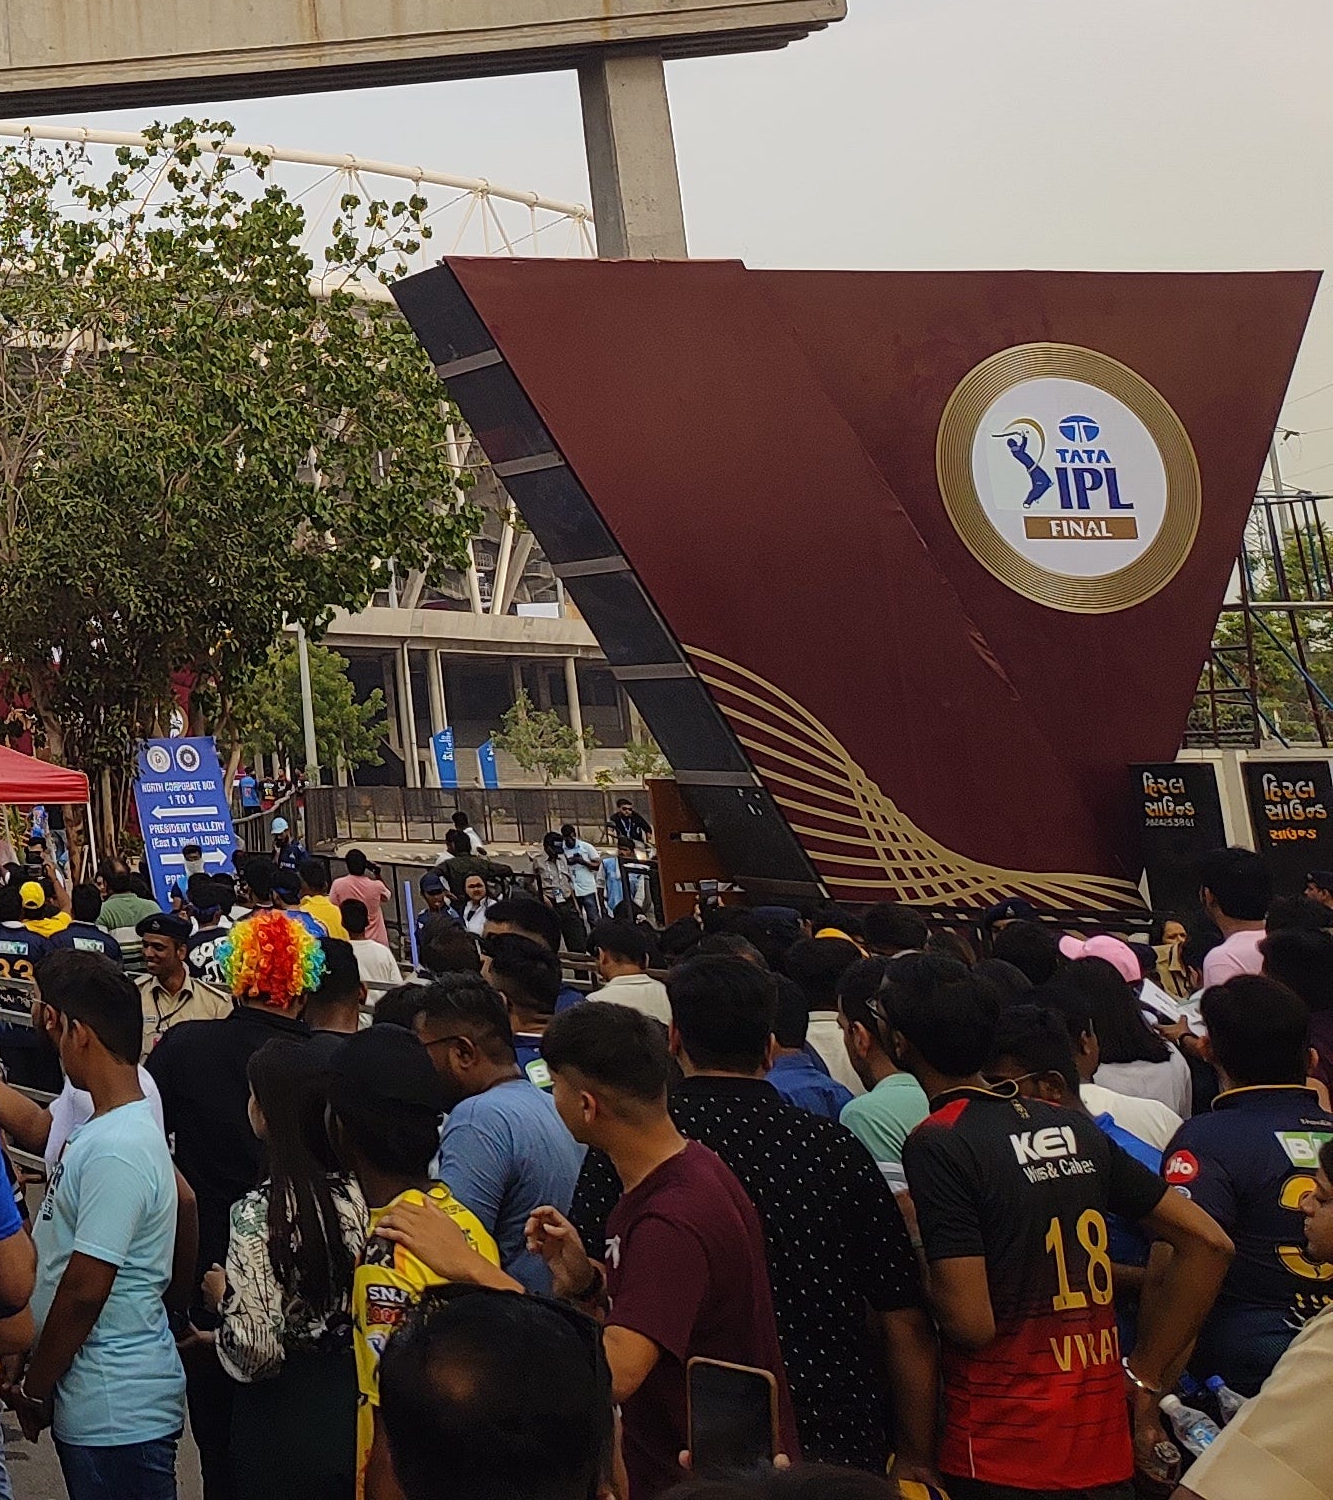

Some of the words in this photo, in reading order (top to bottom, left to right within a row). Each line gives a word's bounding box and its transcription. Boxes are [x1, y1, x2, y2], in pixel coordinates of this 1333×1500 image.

[1055, 448, 1111, 464] TATA
[1055, 467, 1134, 510] IPL
[1049, 520, 1113, 538] FINAL
[141, 782, 164, 793] NORTH
[175, 794, 187, 804] TO
[149, 822, 191, 834] PRESIDENT
[192, 821, 225, 832] GALLERY
[200, 835, 231, 846] LOUNGE
[1009, 1125, 1078, 1166] KEI
[1045, 1161, 1060, 1179] &
[1059, 1157, 1097, 1176] Cabes
[1166, 1157, 1194, 1176] Jio
[1044, 1208, 1114, 1312] 18
